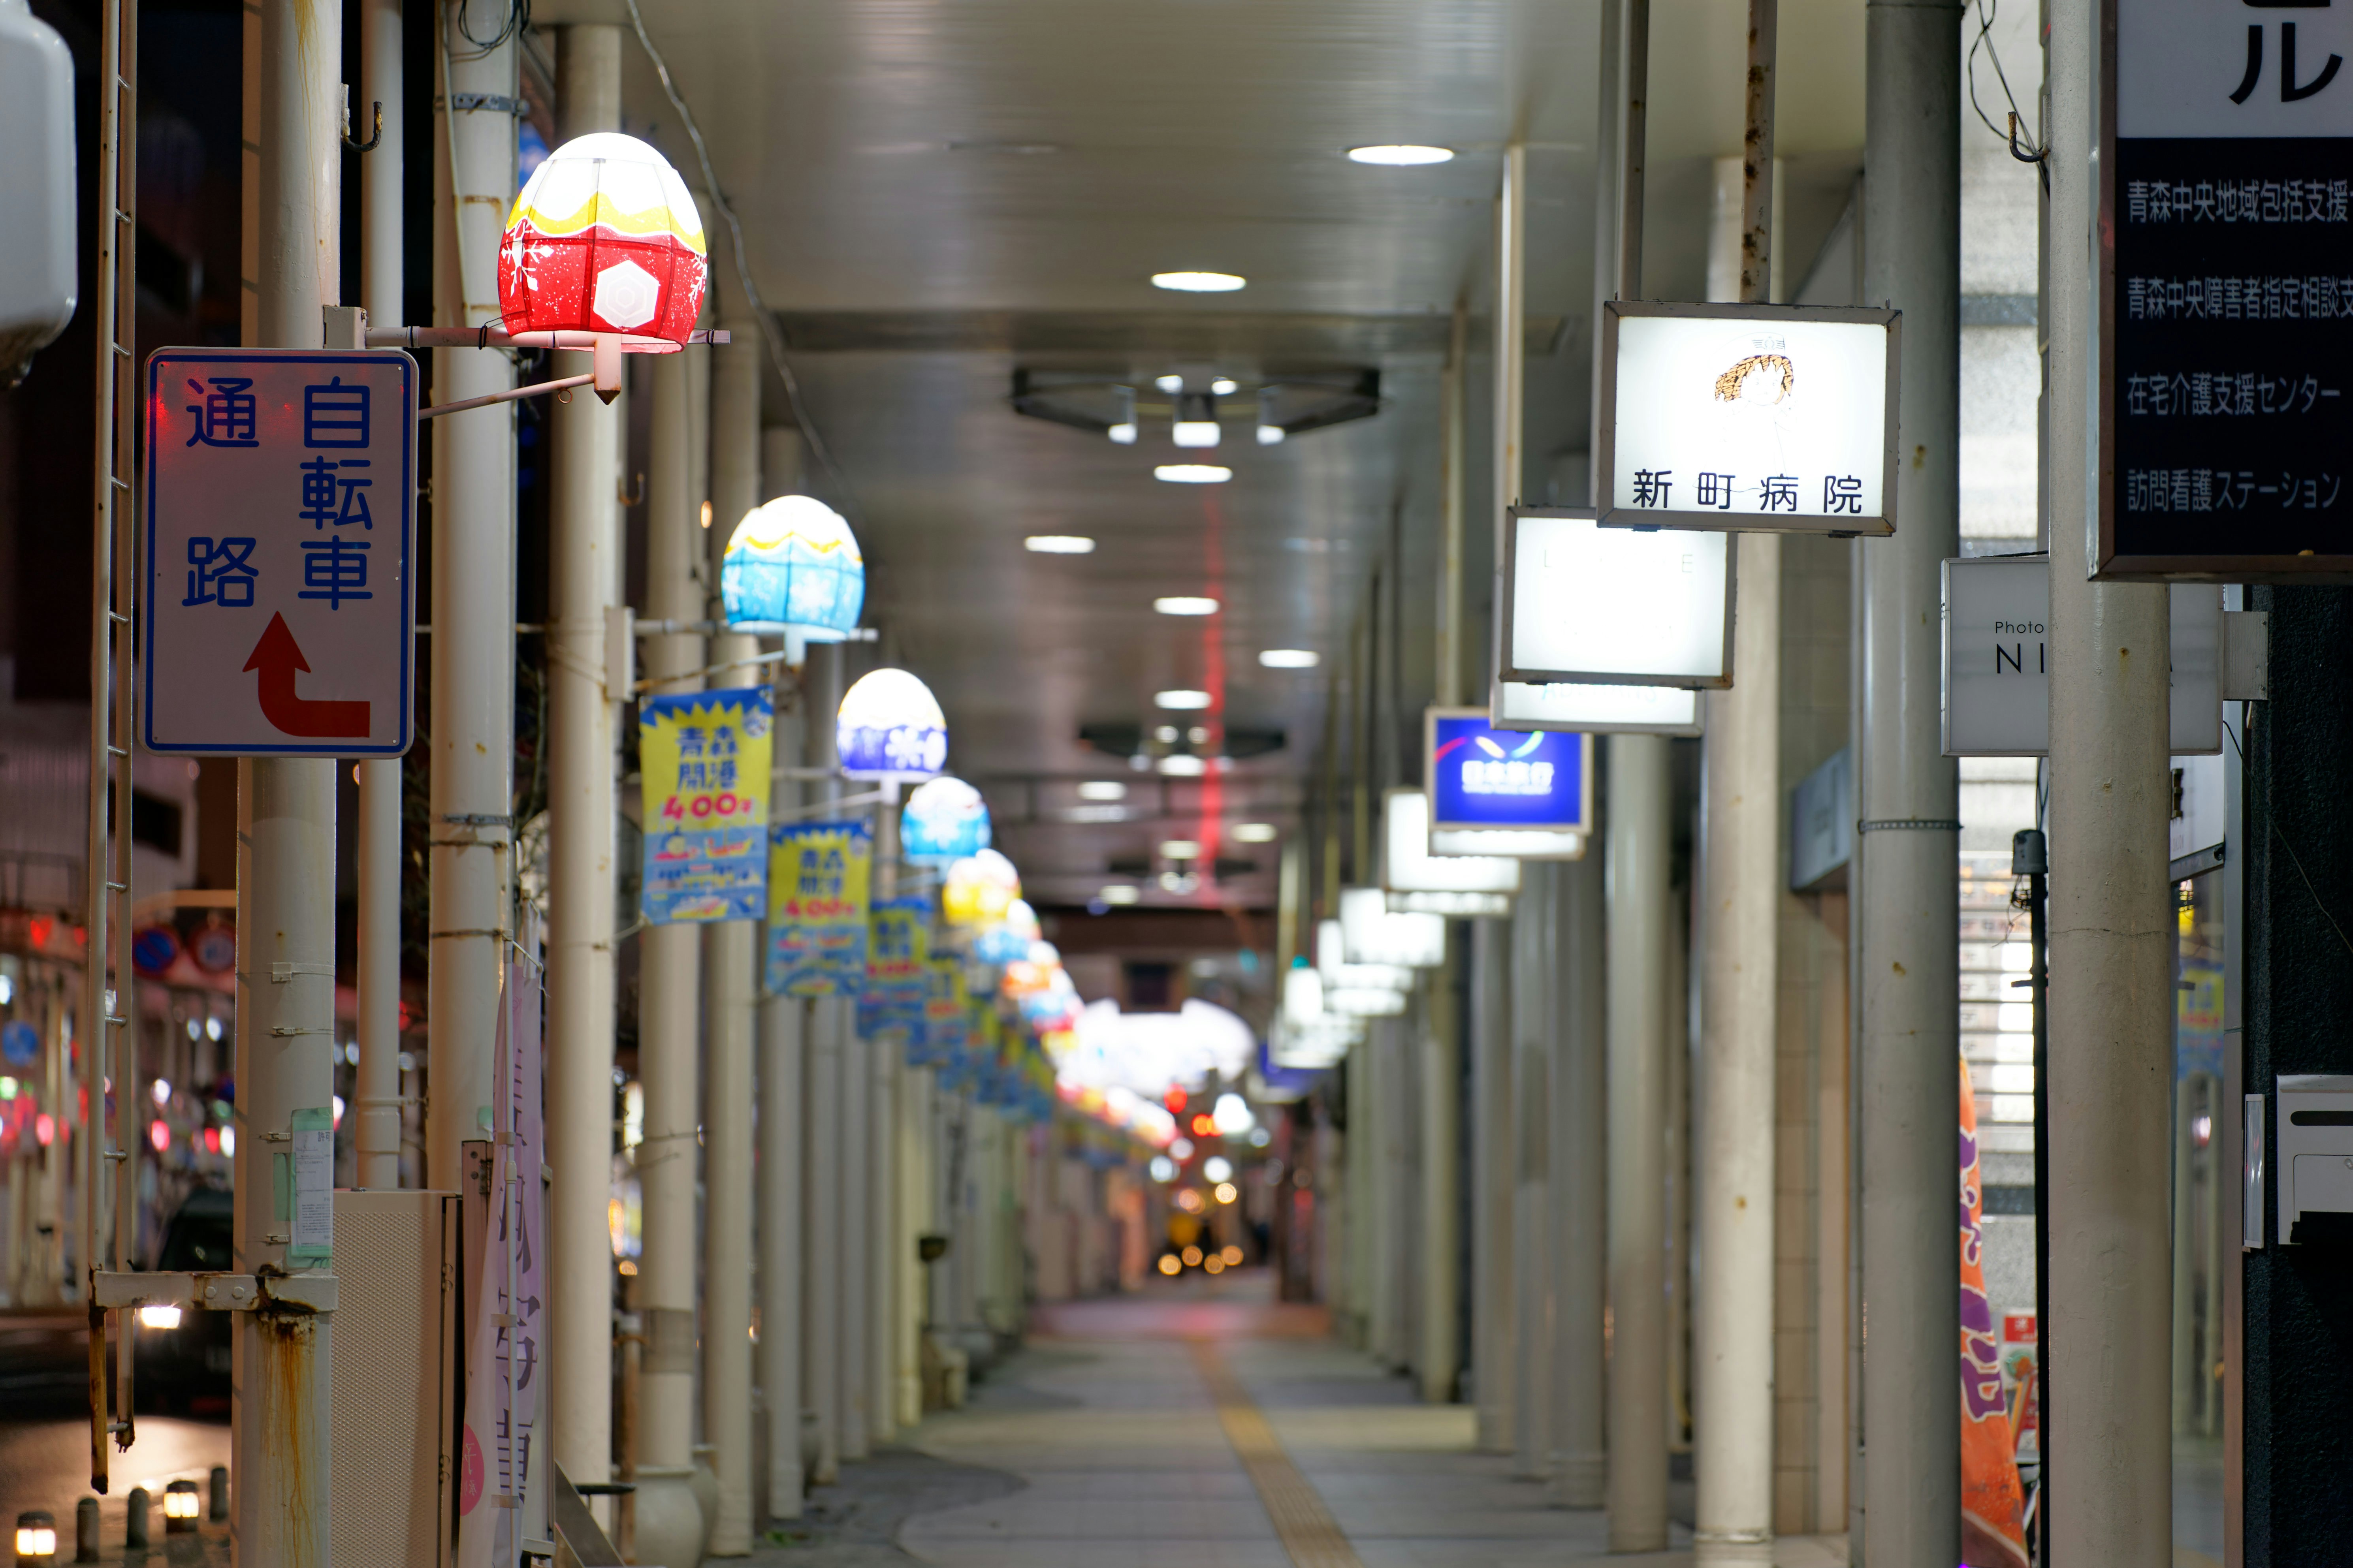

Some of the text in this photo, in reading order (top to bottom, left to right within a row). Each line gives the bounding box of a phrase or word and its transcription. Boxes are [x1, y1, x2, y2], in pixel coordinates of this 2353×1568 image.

[2227, 0, 2343, 105] ル
[2128, 179, 2353, 222] 青森中央地域包括支援
[2128, 276, 2353, 319] 青森中央障害者指定相談支
[2128, 372, 2341, 416] 在宅介護支援センター
[182, 378, 259, 607] 通路
[298, 376, 373, 611] 自転車
[1632, 468, 1862, 514] 新町病院
[2128, 468, 2341, 512] 訪問看護ステーション
[1996, 621, 2044, 633] Photo
[675, 724, 740, 757] 青森
